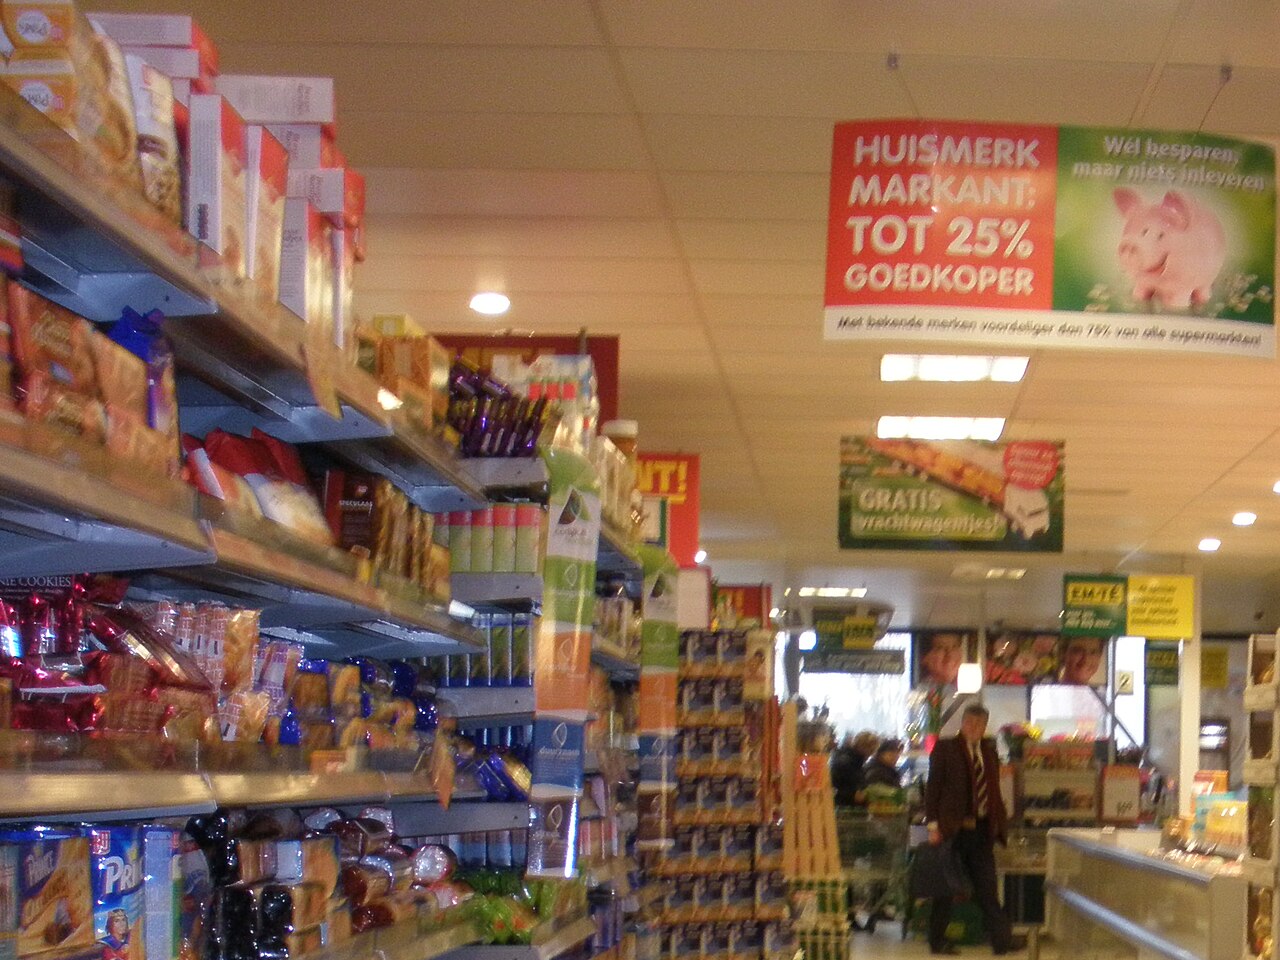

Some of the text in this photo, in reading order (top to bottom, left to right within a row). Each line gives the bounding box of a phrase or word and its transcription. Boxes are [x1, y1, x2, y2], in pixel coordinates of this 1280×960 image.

[853, 134, 1041, 168] HUISMERK
[1073, 161, 1265, 191] maar niets inleveren
[845, 215, 1035, 260] TOT 25%
[843, 263, 1035, 298] GOEDKOPER
[638, 461, 688, 493] NT!
[859, 488, 943, 512] GRATIS
[19, 575, 71, 588] COOKIES
